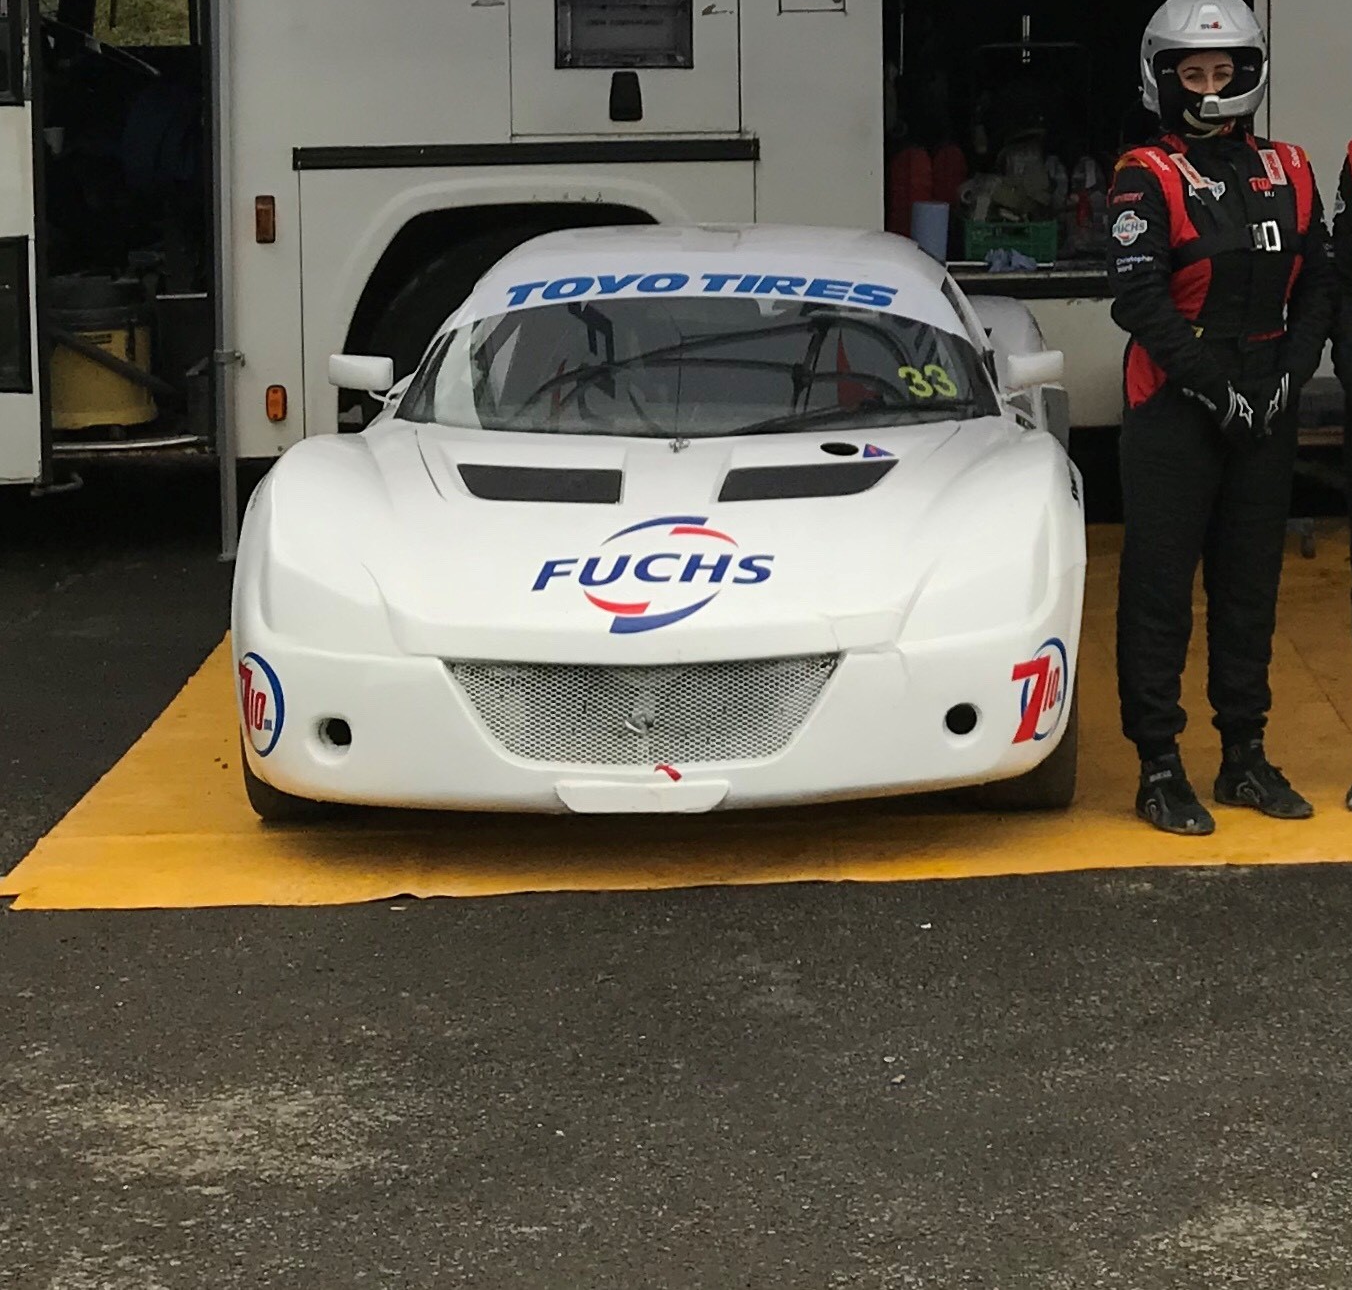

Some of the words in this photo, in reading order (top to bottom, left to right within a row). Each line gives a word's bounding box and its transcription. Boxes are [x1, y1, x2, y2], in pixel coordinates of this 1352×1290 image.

[506, 273, 690, 307] TOYO
[700, 273, 898, 307] TIRES
[898, 364, 958, 398] 33
[531, 552, 775, 592] FUCHS
[1012, 655, 1061, 744] 710
